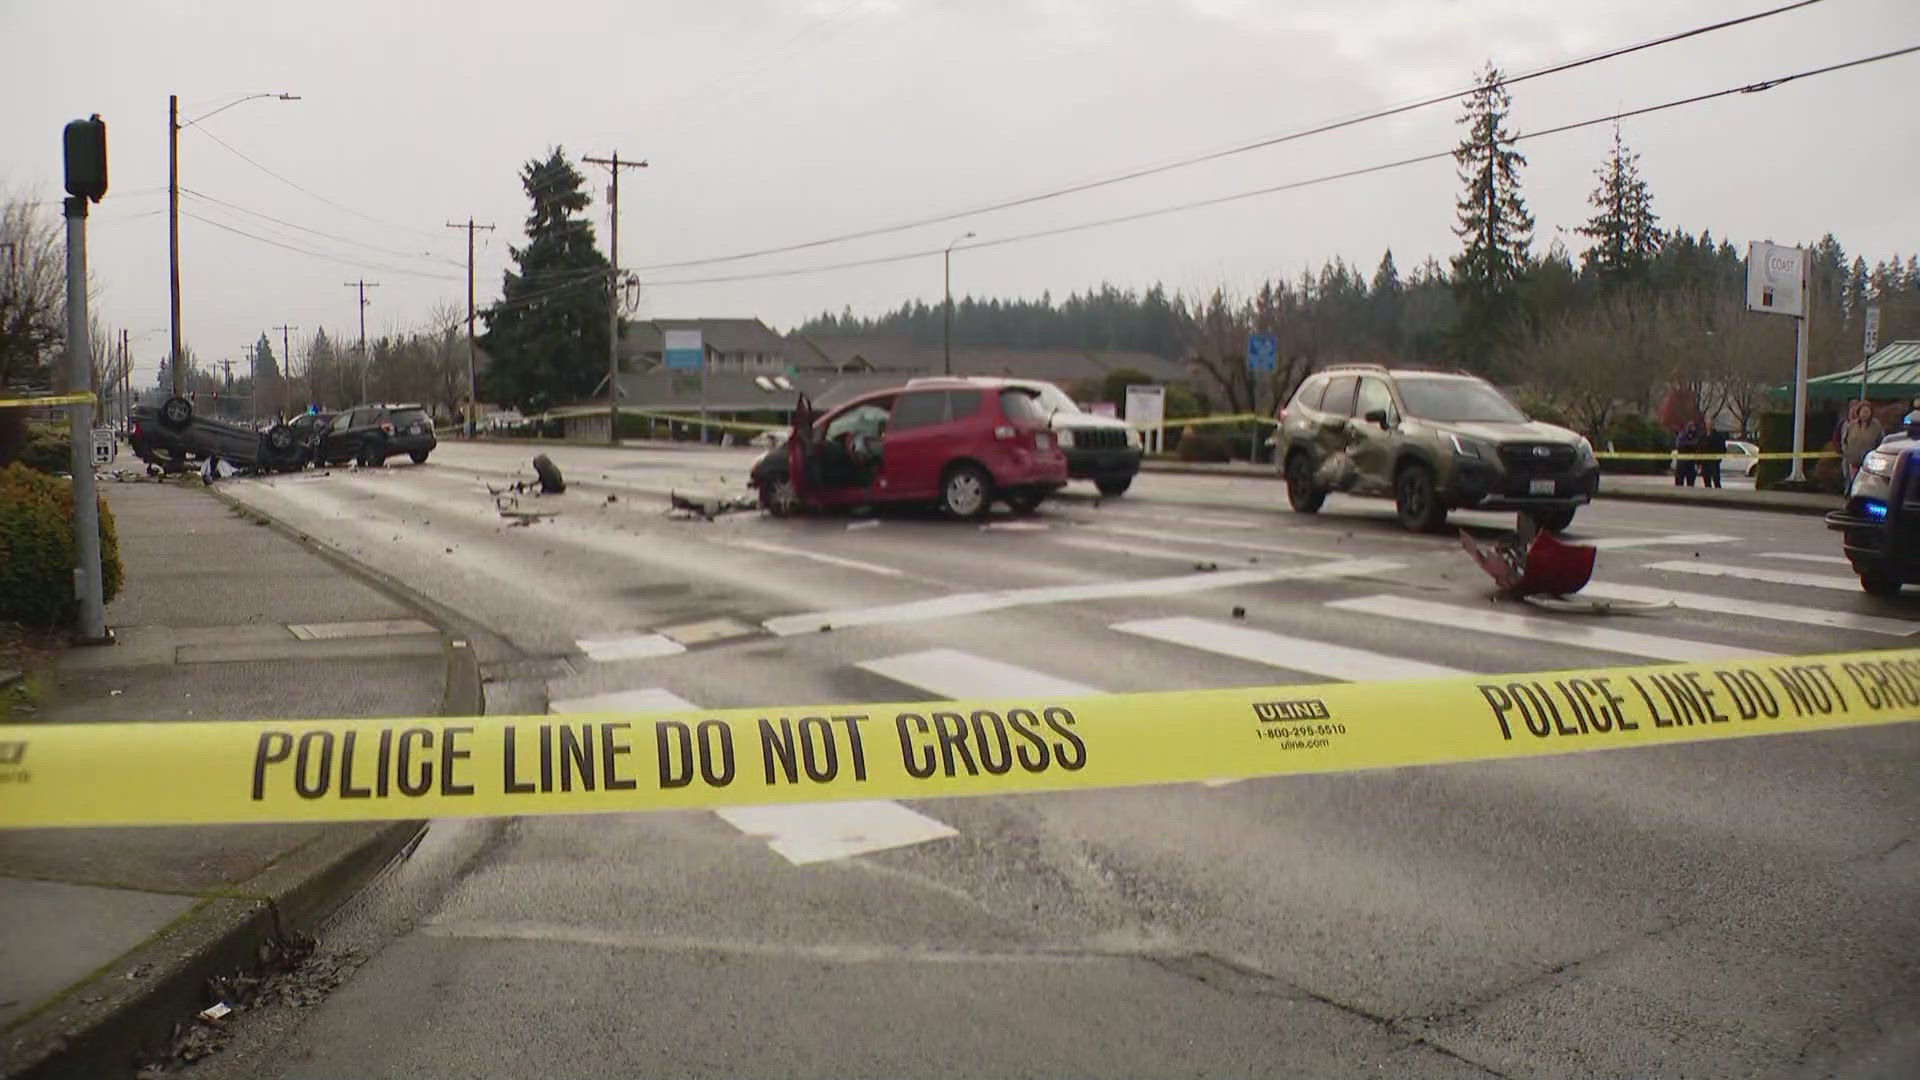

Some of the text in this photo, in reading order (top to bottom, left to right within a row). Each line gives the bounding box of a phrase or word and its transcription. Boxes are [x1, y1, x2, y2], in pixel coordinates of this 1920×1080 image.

[1771, 257, 1794, 272] COAST
[1257, 701, 1325, 719] ULINE
[1477, 677, 1639, 740] POLICE
[1627, 671, 1729, 728] LINE
[1713, 669, 1779, 720] DO
[1769, 664, 1848, 717] NOT
[1256, 723, 1346, 740] 1-800-295-5510
[252, 706, 1087, 800] POLICE LINE DO NOT CROSS
